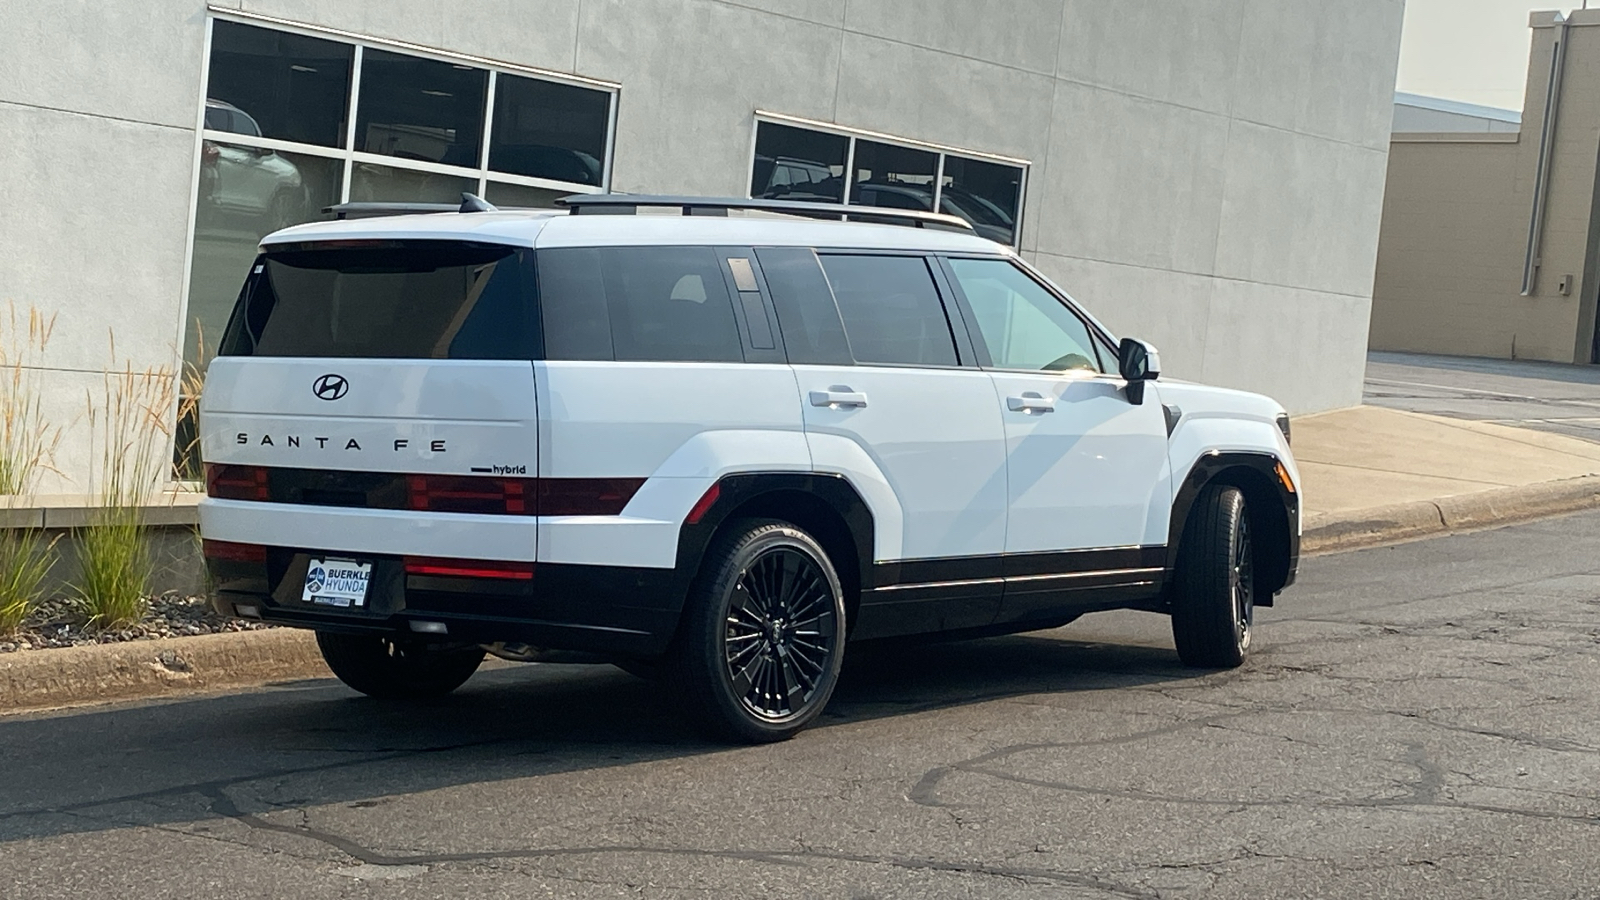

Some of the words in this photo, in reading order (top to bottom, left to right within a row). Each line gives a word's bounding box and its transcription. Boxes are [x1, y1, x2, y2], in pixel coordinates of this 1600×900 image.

[236, 432, 362, 451] SANTA
[393, 439, 447, 452] FE
[493, 464, 526, 475] hybrid
[328, 568, 370, 580] BUERKLE
[325, 579, 365, 592] HYUNDA
